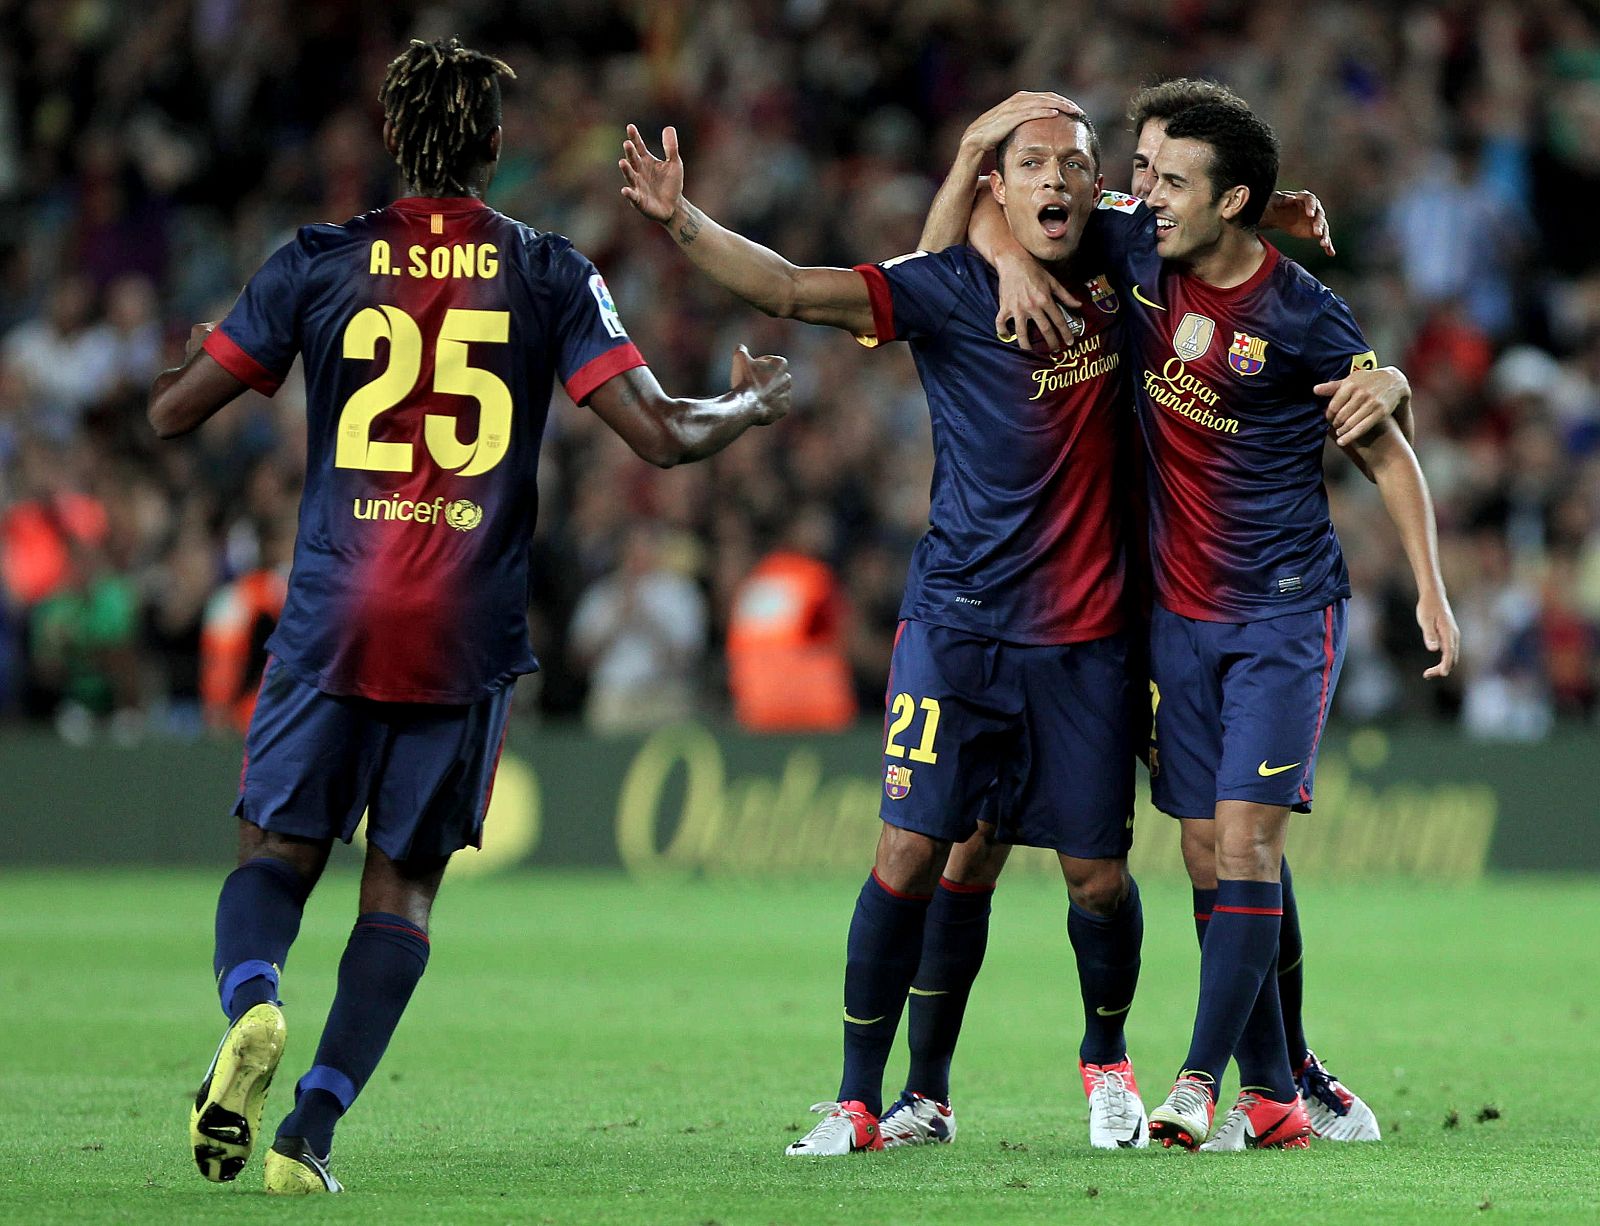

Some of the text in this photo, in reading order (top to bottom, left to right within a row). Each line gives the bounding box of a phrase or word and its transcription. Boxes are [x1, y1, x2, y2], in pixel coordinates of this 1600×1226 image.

[370, 240, 499, 279] A. SONG
[335, 304, 513, 477] 25
[1028, 352, 1119, 401] Foundation
[1163, 357, 1221, 407] Qatar
[1143, 370, 1239, 434] Foundation
[353, 492, 444, 525] unicef
[955, 596, 982, 606] DRI-FIT
[885, 692, 941, 765] 21
